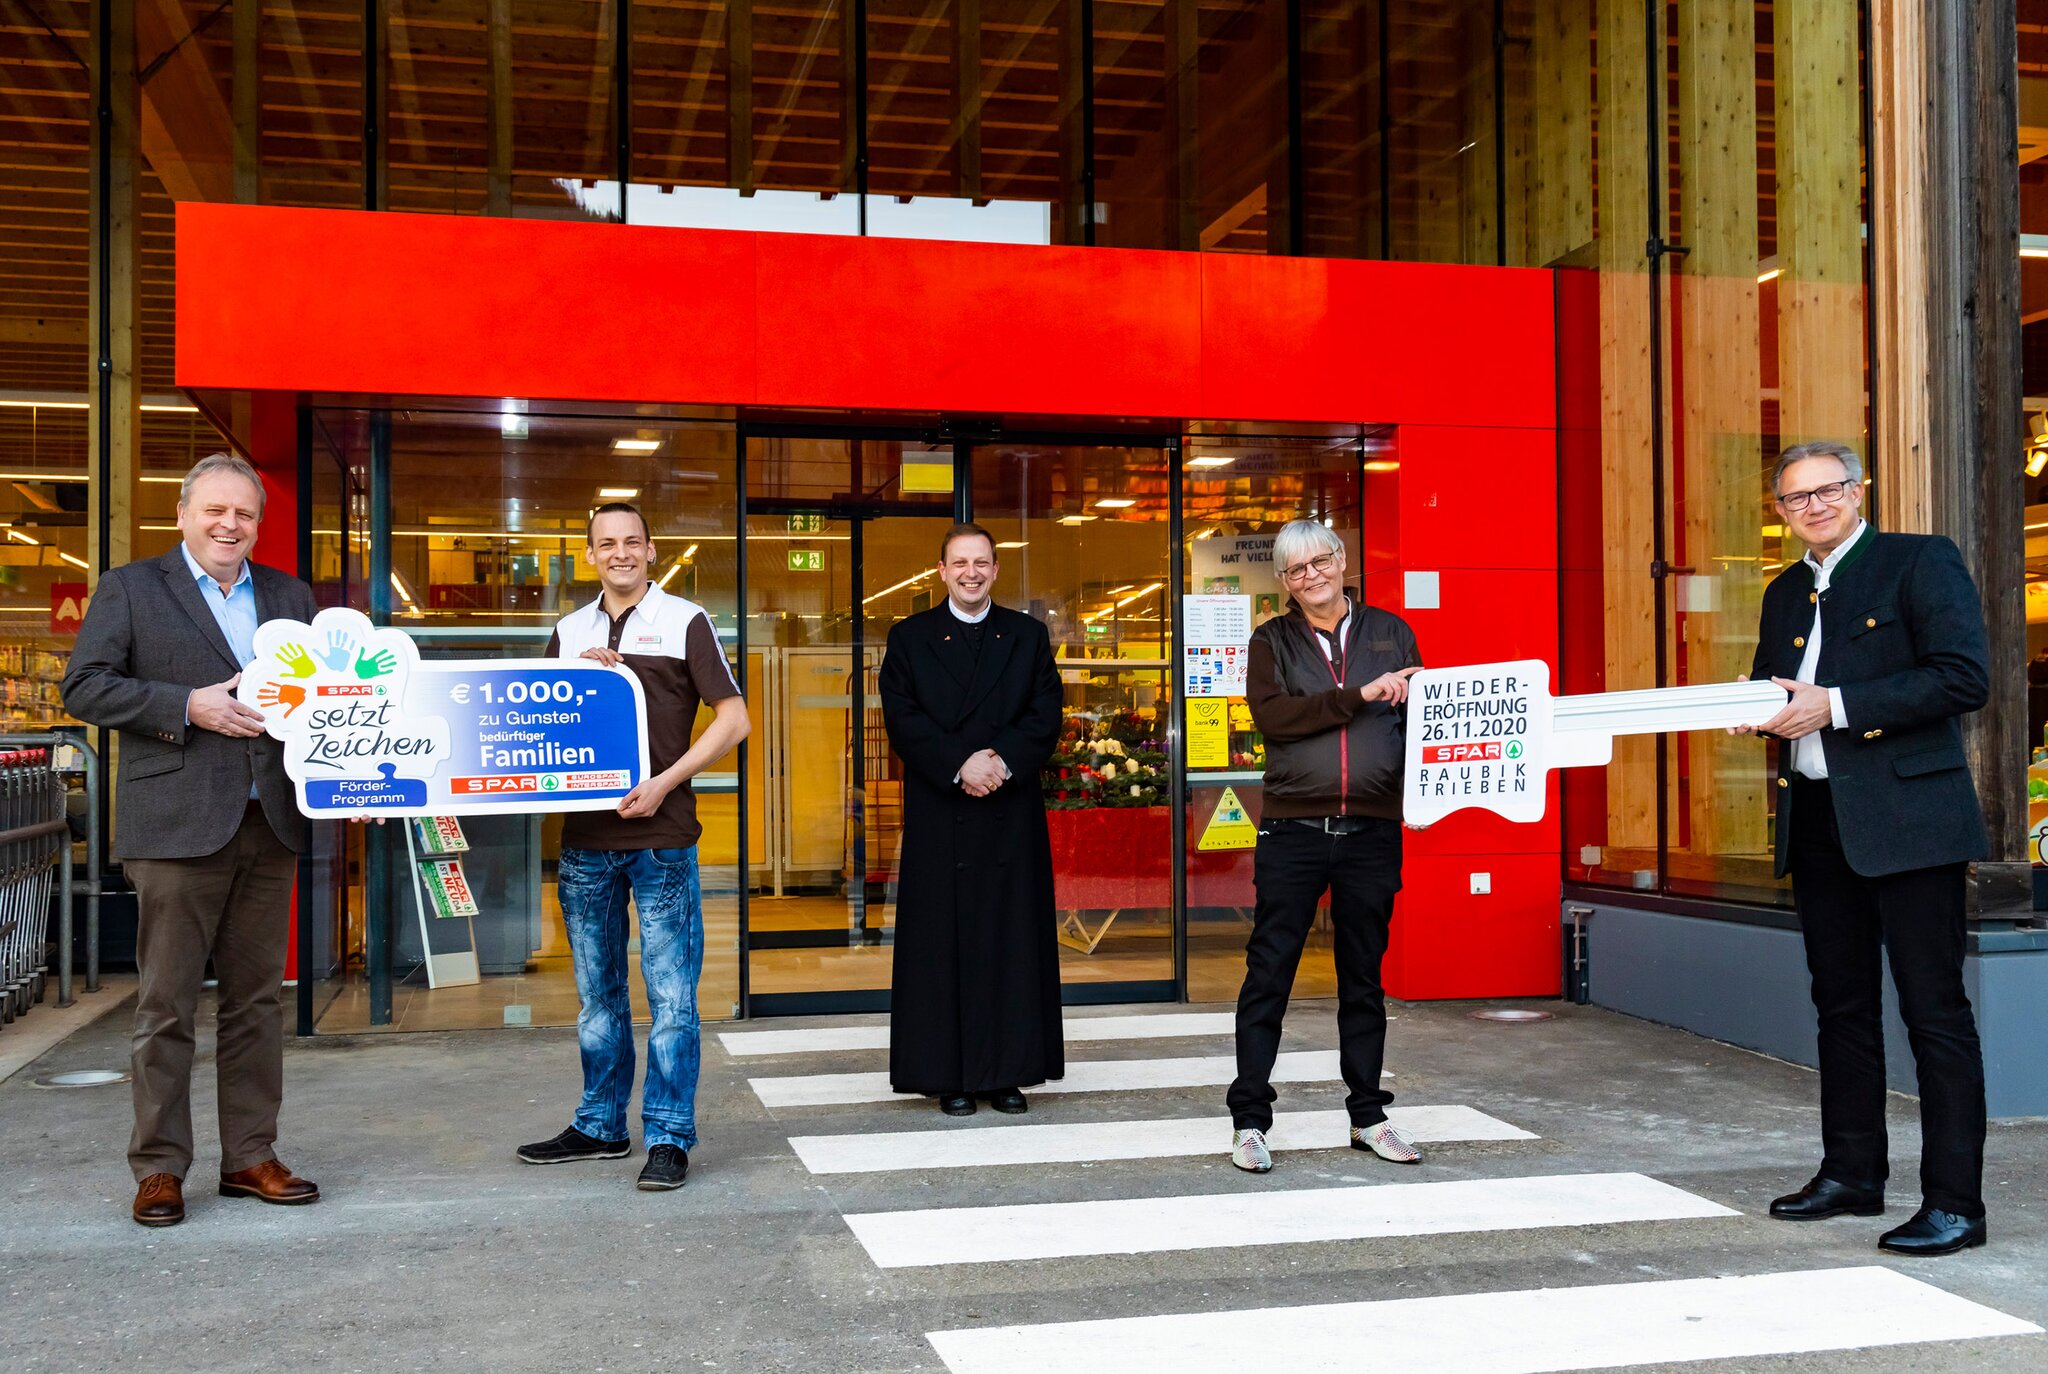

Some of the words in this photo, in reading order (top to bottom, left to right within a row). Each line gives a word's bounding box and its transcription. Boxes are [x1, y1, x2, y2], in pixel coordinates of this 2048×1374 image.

[1221, 553, 1241, 563] HAT
[327, 686, 372, 695] SPAR
[450, 683, 471, 704] €
[479, 680, 597, 706] 1.000,-
[1424, 677, 1529, 700] WIEDER-
[308, 699, 396, 729] setzt
[478, 714, 500, 726] zu
[506, 710, 581, 725] Gunsten
[1423, 697, 1527, 721] ERÖFFNUNG
[1209, 718, 1219, 727] 99
[1422, 717, 1527, 741] 26.11.2020
[479, 731, 545, 743] bedürftiger
[304, 730, 436, 770] Zeichen
[480, 742, 595, 768] Familien
[1437, 744, 1500, 761] SPAR
[1420, 763, 1526, 782] RAUBIK
[340, 781, 391, 792] Förder-
[468, 777, 536, 791] SPAR
[570, 781, 620, 789] INTERSPAR
[1420, 778, 1526, 796] TRIEBEN
[332, 794, 405, 806] Programm
[447, 816, 460, 838] PAR
[439, 864, 449, 876] IST
[443, 877, 460, 901] NEU
[452, 870, 469, 902] SPAR
